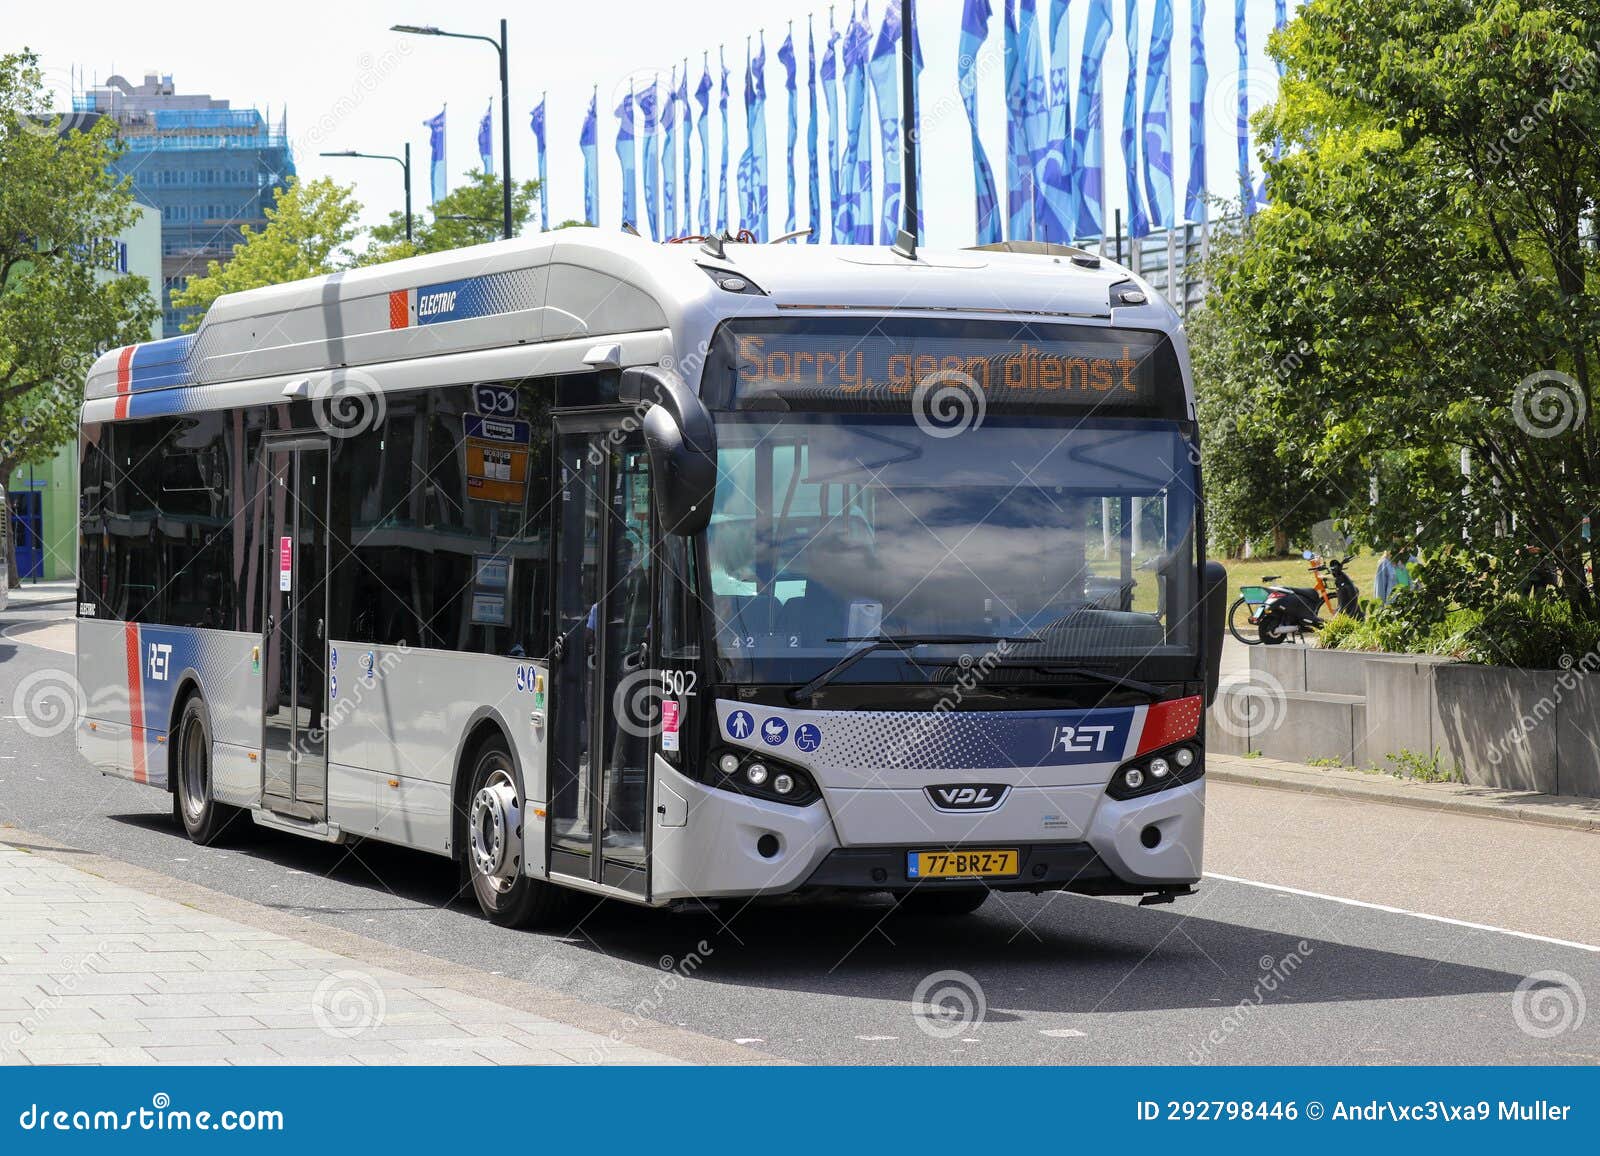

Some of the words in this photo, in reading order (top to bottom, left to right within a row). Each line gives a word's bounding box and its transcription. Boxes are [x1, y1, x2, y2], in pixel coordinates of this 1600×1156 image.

[419, 291, 457, 316] ELECTRIC
[739, 335, 873, 393] Sorry,
[888, 355, 990, 393] geen
[1004, 344, 1136, 392] dienst
[747, 637, 755, 648] 2
[790, 636, 798, 647] 2
[147, 642, 172, 681] RET
[660, 669, 697, 696] 1502
[1051, 725, 1114, 752] RET
[938, 787, 996, 804] VDL
[927, 854, 1009, 873] 77-BRZ-7
